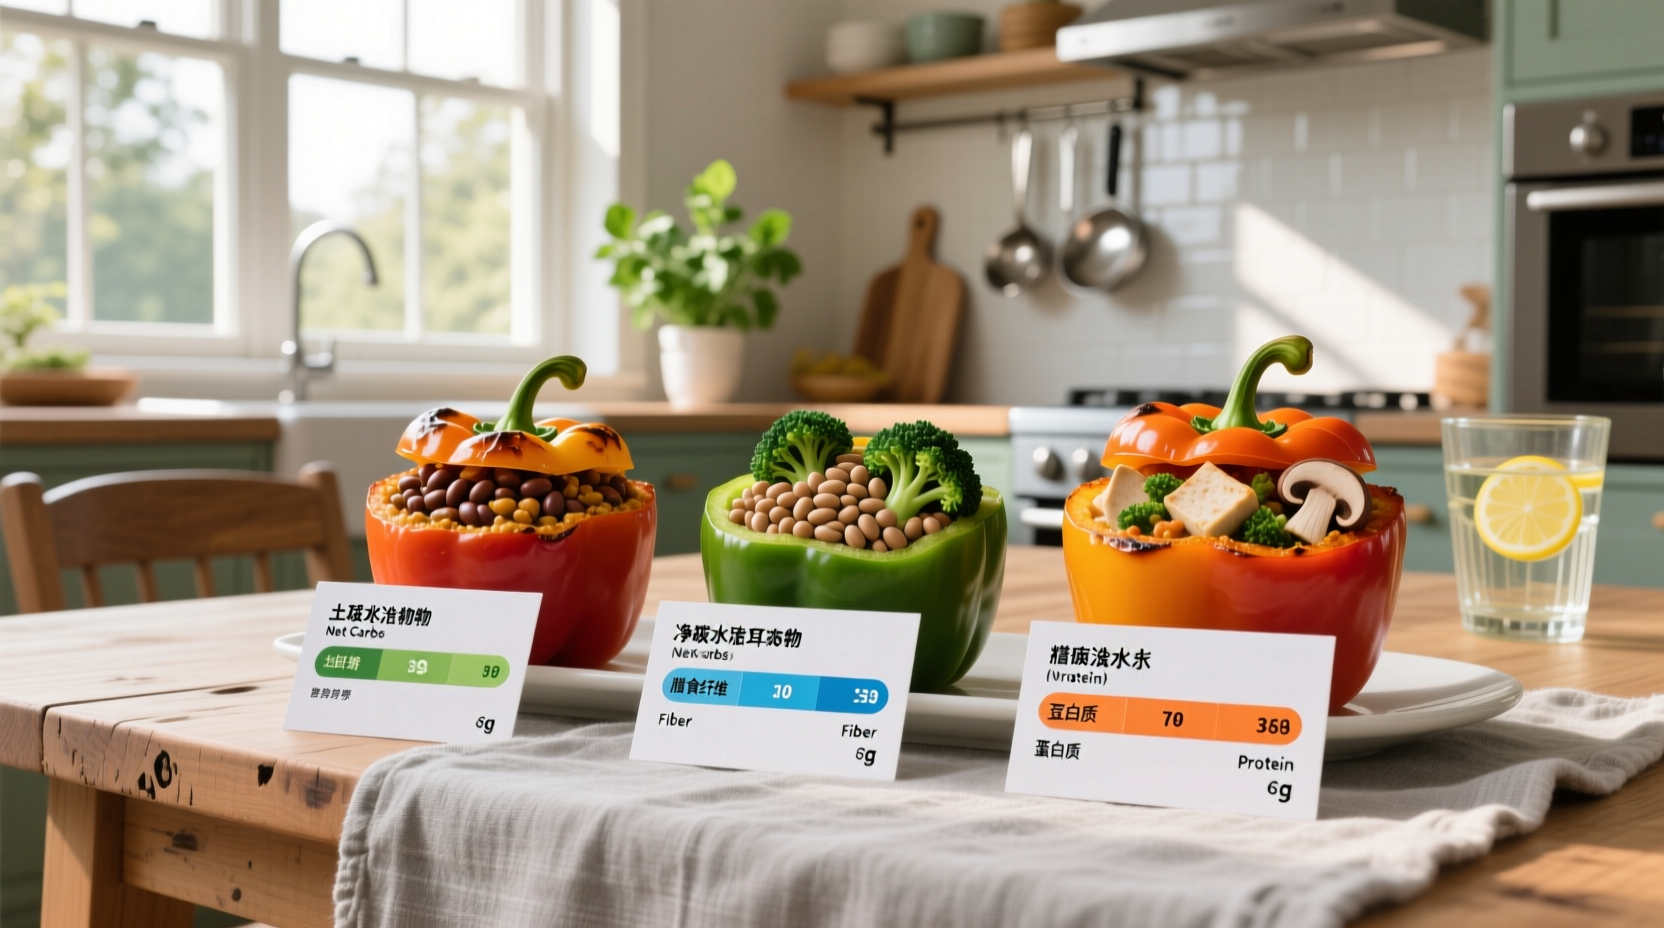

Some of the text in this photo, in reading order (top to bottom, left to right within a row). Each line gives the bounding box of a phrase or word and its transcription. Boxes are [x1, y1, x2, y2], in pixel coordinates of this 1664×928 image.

[325, 625, 347, 638] Net
[475, 716, 496, 735] 6g
[841, 724, 878, 739] Fiber
[855, 747, 877, 767] 6g
[1238, 754, 1294, 772] Protein
[1267, 780, 1293, 803] 6g
